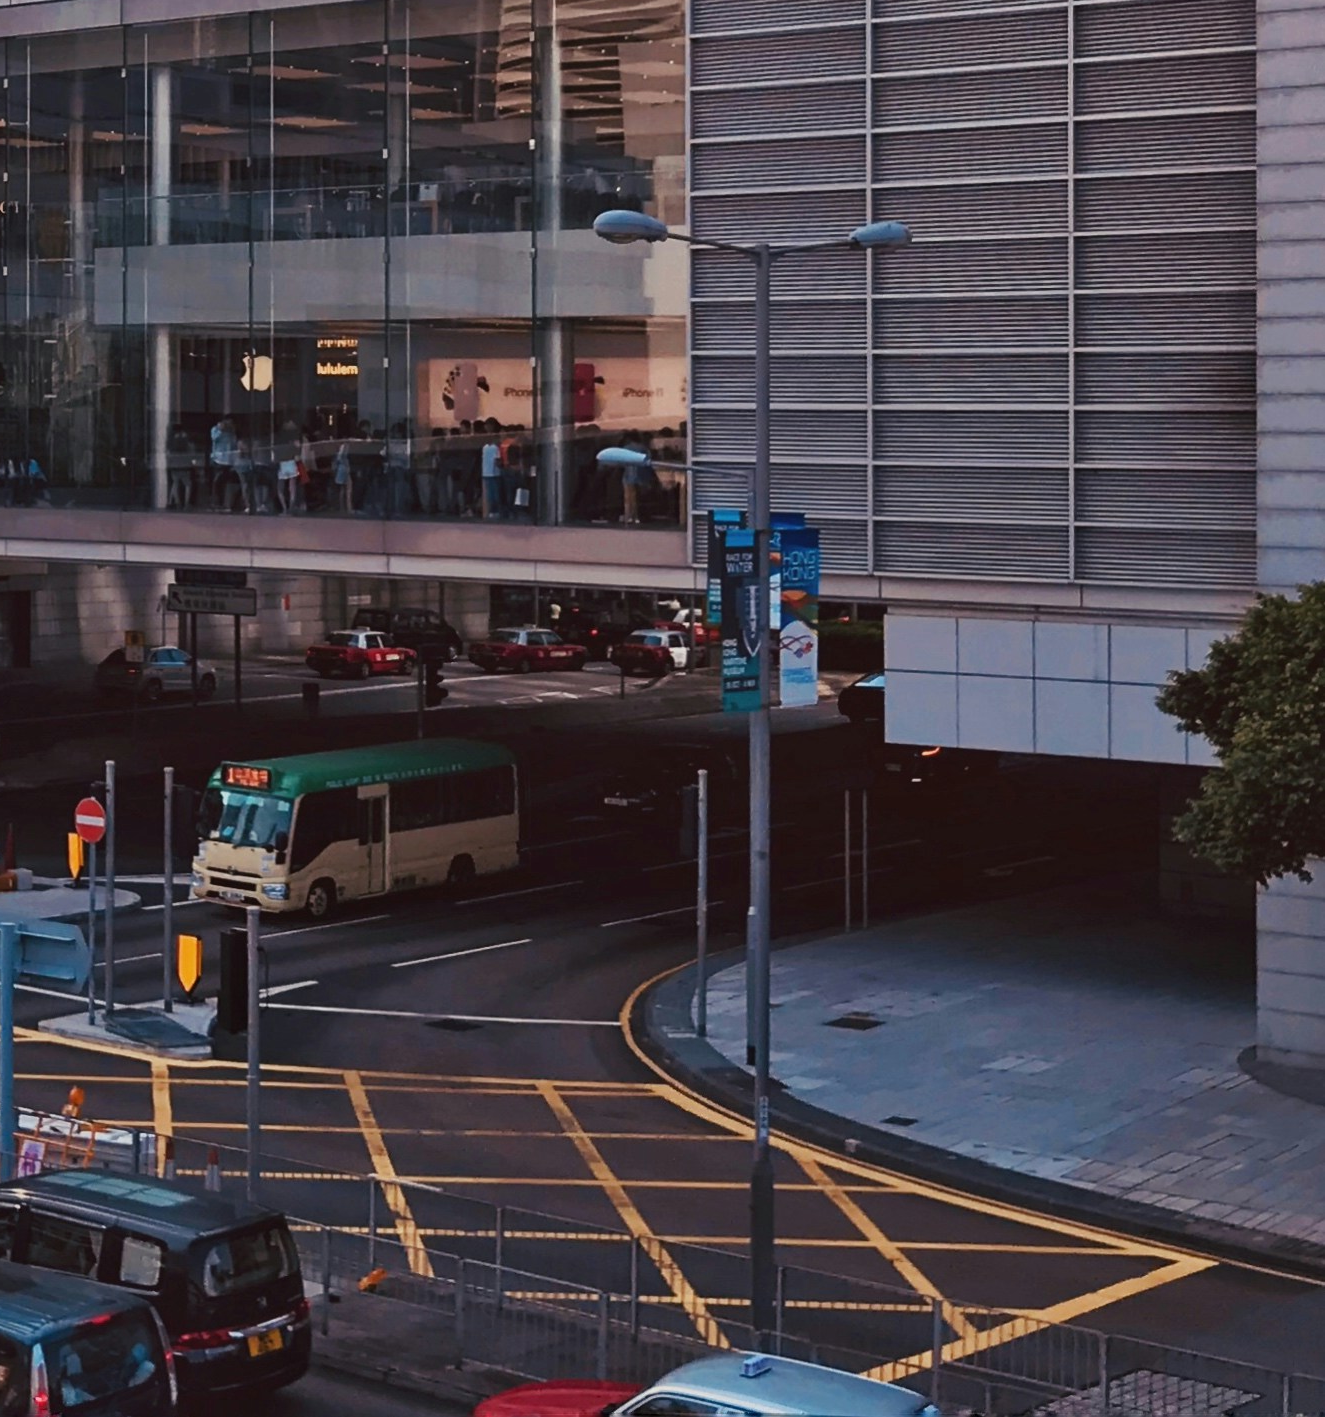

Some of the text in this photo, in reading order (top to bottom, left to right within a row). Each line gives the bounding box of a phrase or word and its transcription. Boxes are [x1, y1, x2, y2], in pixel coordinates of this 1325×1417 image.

[504, 387, 533, 397] iPhon
[622, 387, 655, 397] iPhone
[783, 550, 816, 565] HONG
[726, 562, 754, 573] WATER
[783, 566, 816, 581] KONG
